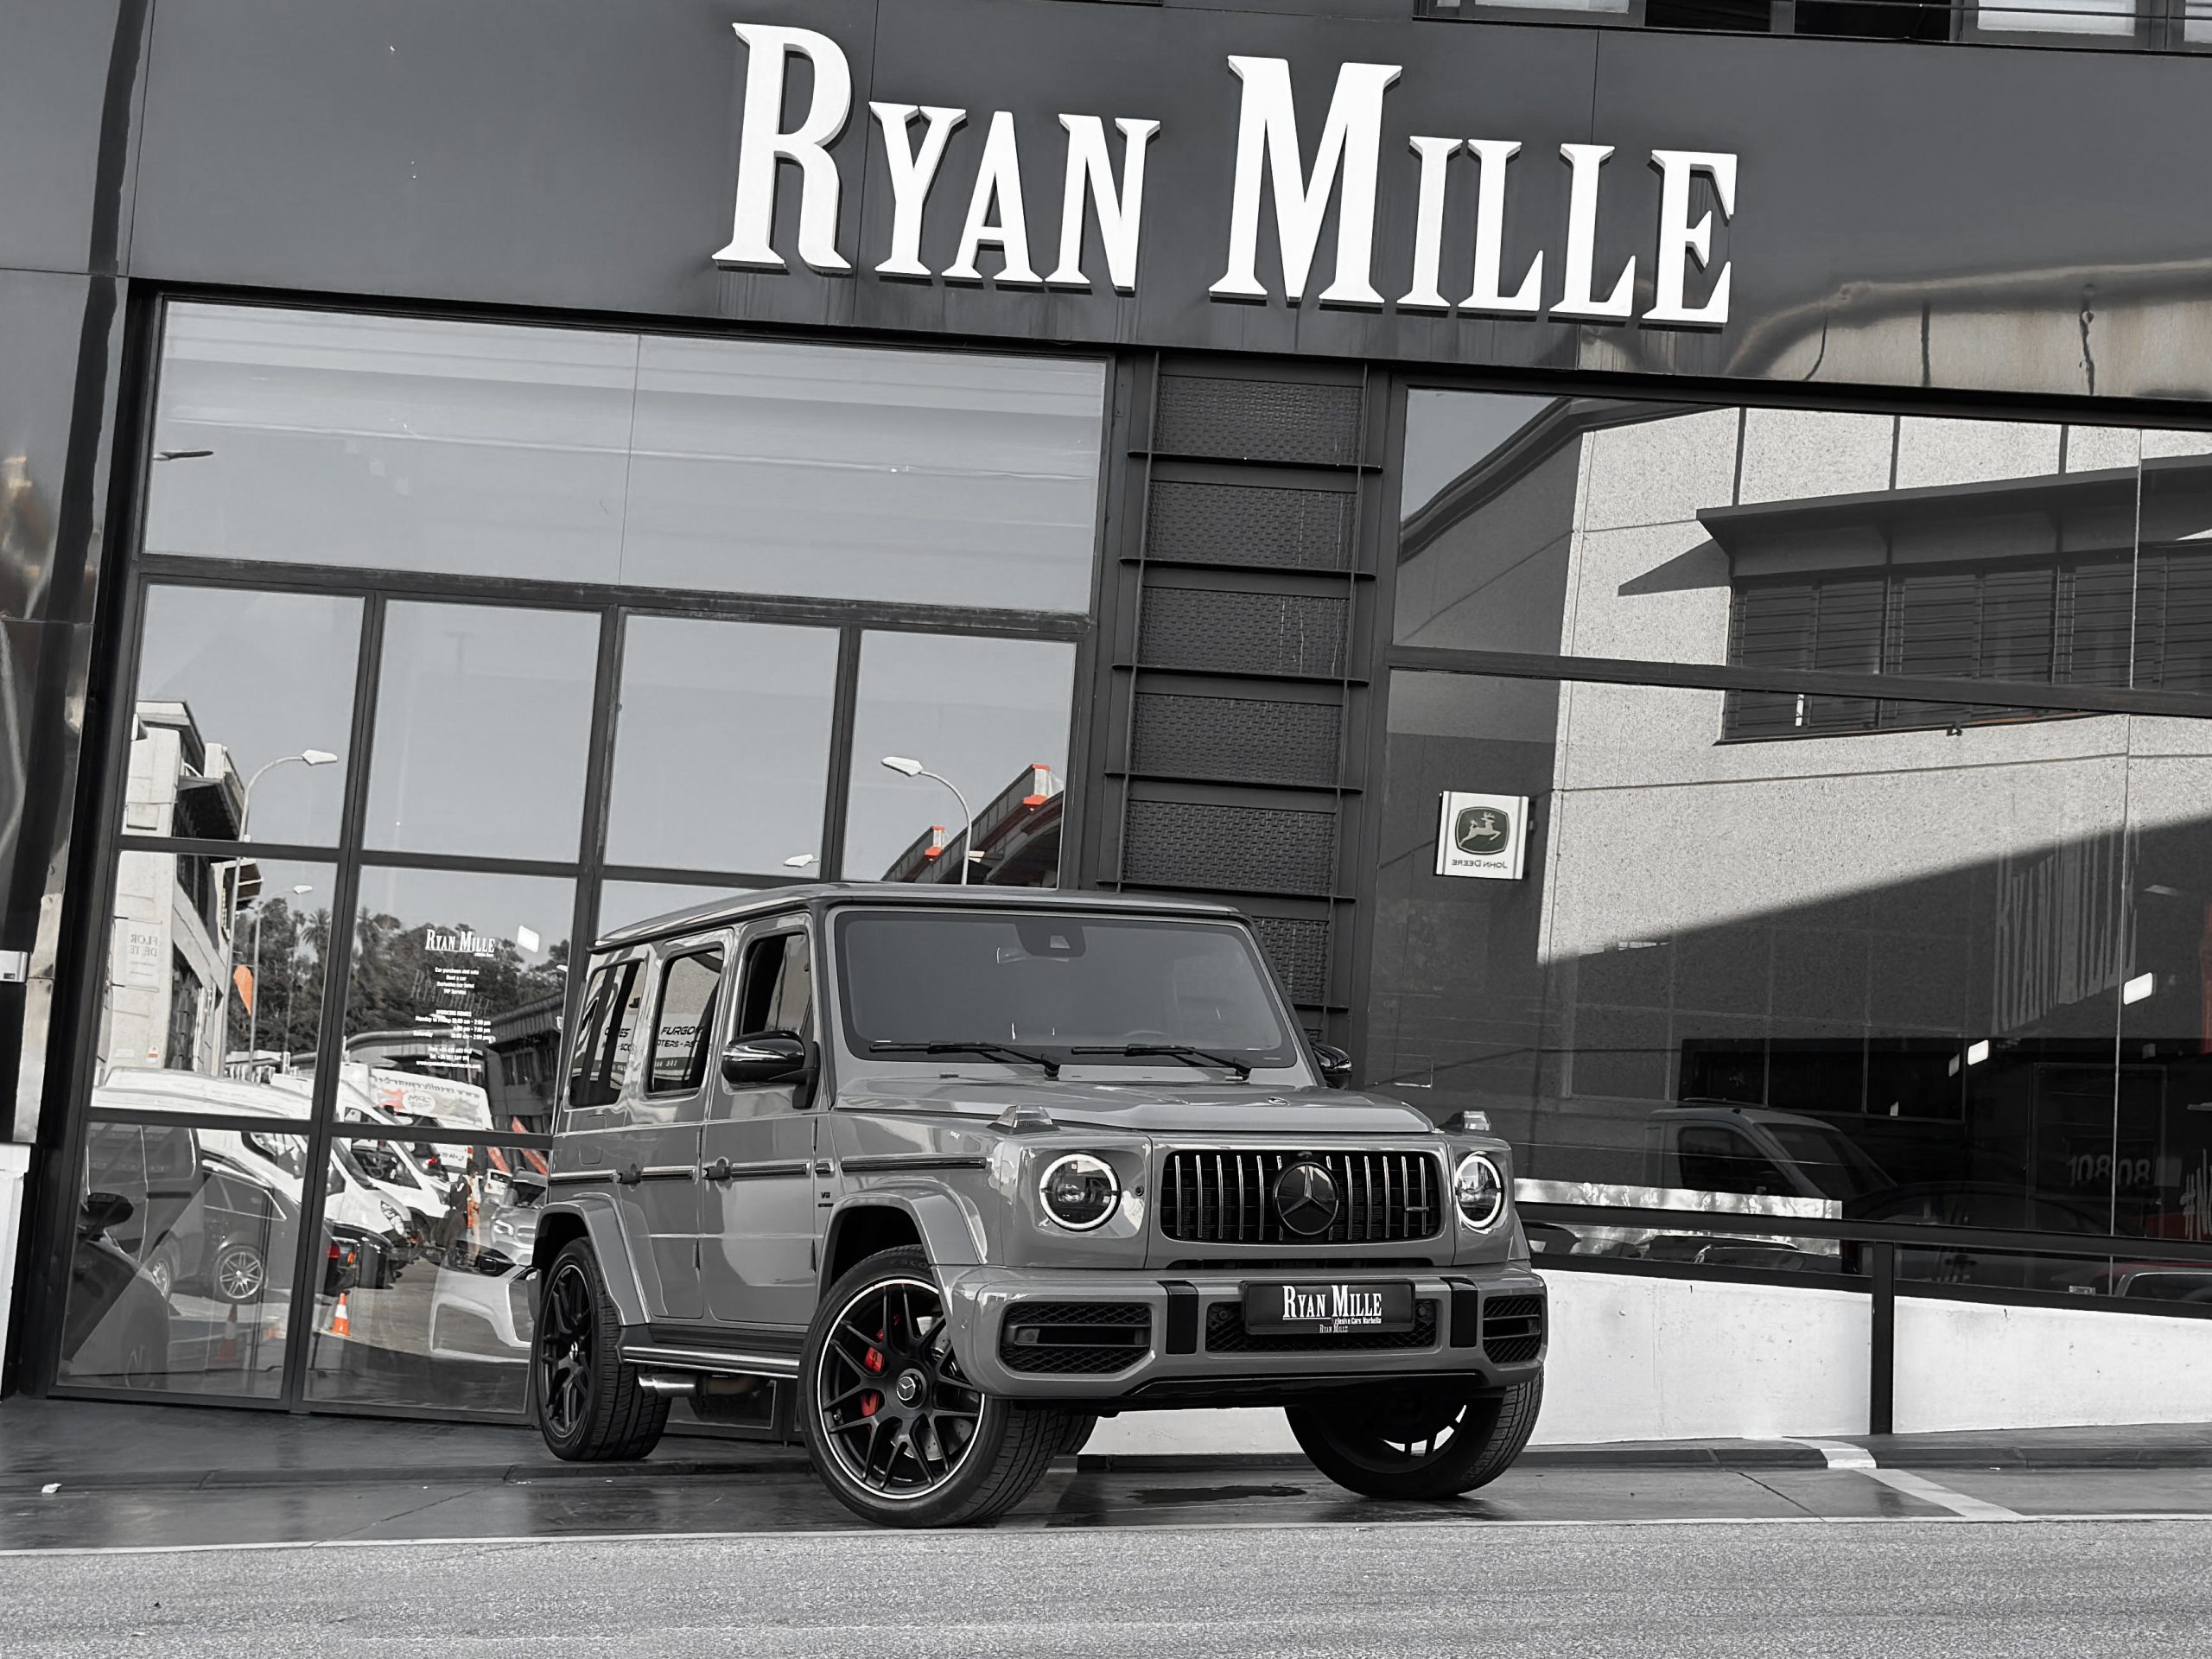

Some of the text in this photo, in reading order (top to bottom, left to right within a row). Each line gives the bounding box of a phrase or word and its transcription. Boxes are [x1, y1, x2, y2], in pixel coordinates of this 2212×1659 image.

[712, 22, 1738, 326] RYAN MILLE
[424, 929, 495, 953] RYAN MILLE
[1282, 1285, 1382, 1318] RYAN MILLE
